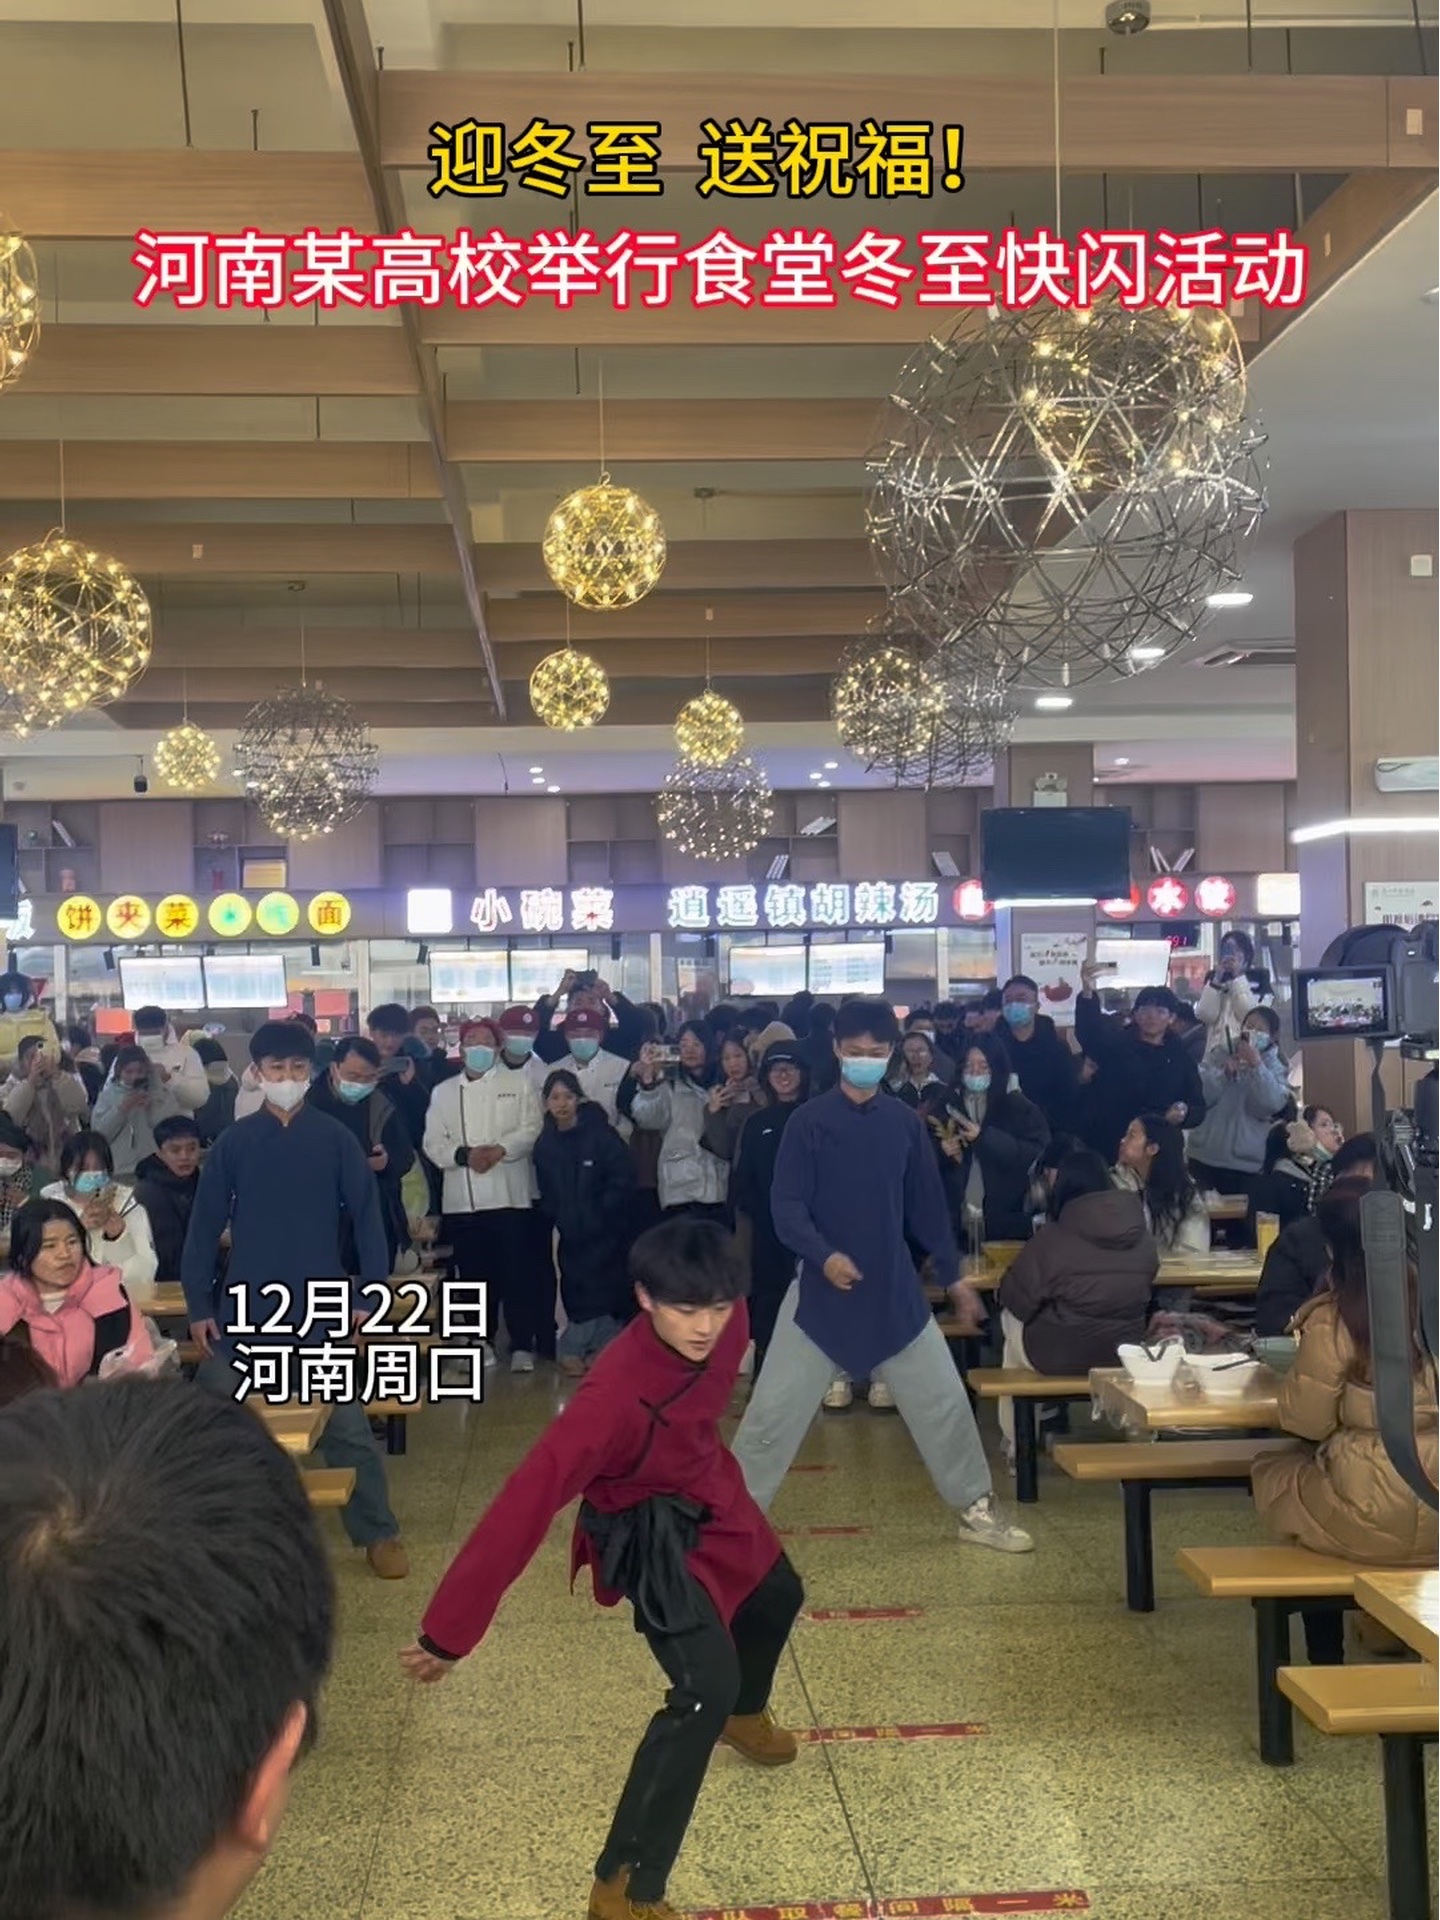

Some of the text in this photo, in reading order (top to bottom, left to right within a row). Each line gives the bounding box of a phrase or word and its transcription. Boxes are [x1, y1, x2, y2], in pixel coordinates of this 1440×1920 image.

[470, 886, 614, 932] 小碗菜
[667, 881, 939, 928] 逍遥镇胡辣汤
